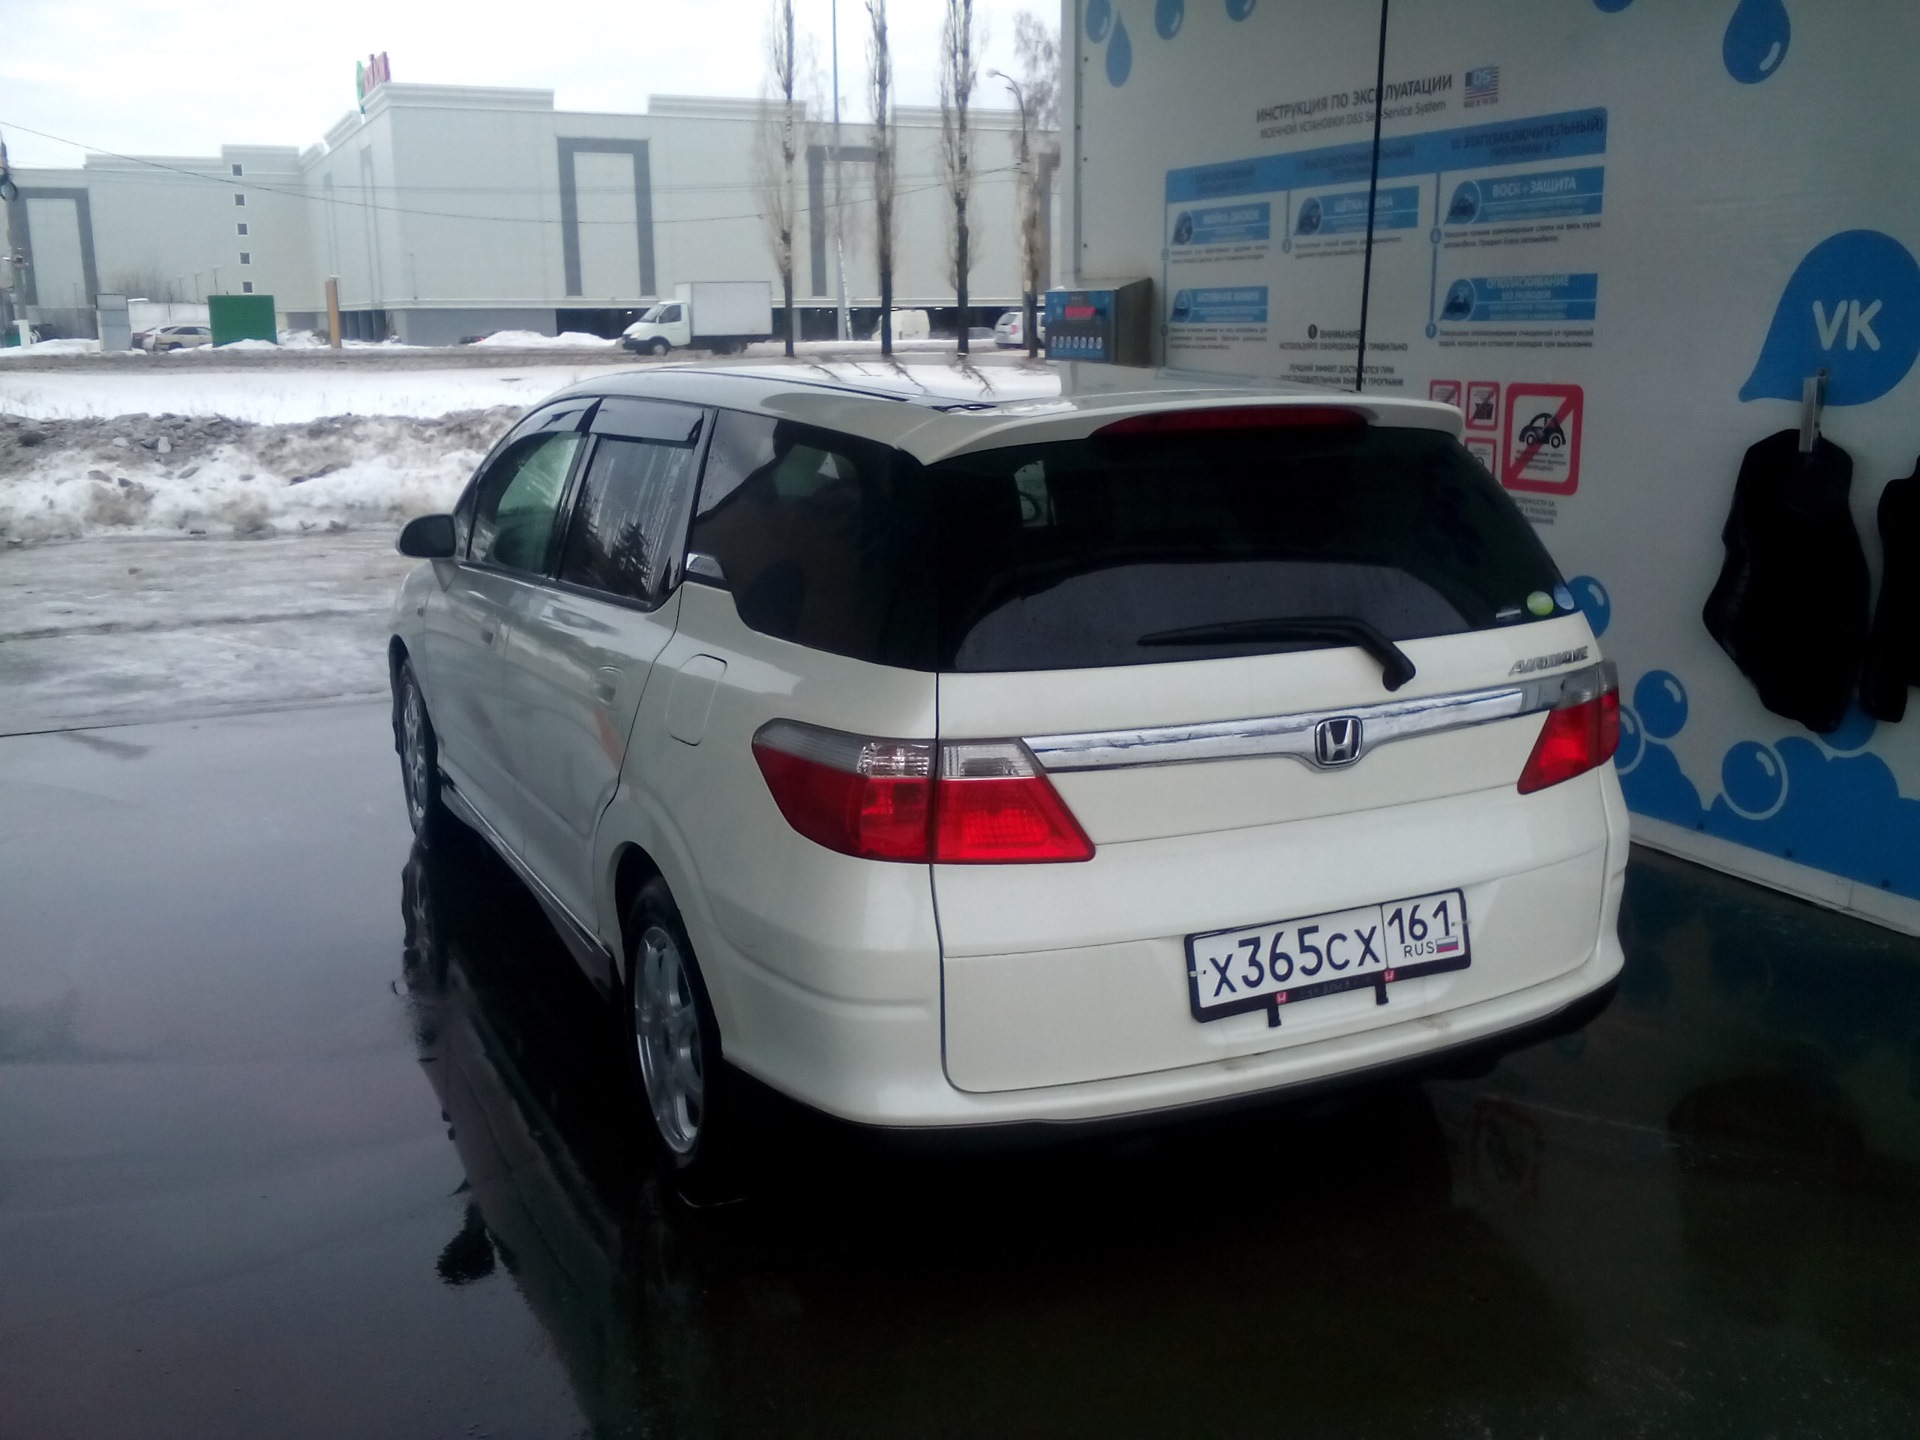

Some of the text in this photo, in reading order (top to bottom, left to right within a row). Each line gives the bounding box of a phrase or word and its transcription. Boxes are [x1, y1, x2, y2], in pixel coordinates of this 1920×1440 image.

[1256, 96, 1329, 123] ИНСТРУКЦИЯ
[1331, 92, 1349, 109] ПО
[1352, 73, 1453, 106] ЭКСЛУАТАЦИИ
[1260, 124, 1297, 139] МОЕЧНОЙ
[1300, 115, 1345, 132] УСТАНОВКИ
[1366, 106, 1413, 123] Se-Service
[1415, 100, 1446, 117] System
[1492, 184, 1521, 199] ВОСК
[1529, 176, 1577, 194] ЗАЩИТА
[1812, 298, 1883, 351] VK
[1209, 899, 1451, 998] Х365СХ 161
[1403, 942, 1436, 959] RUS
